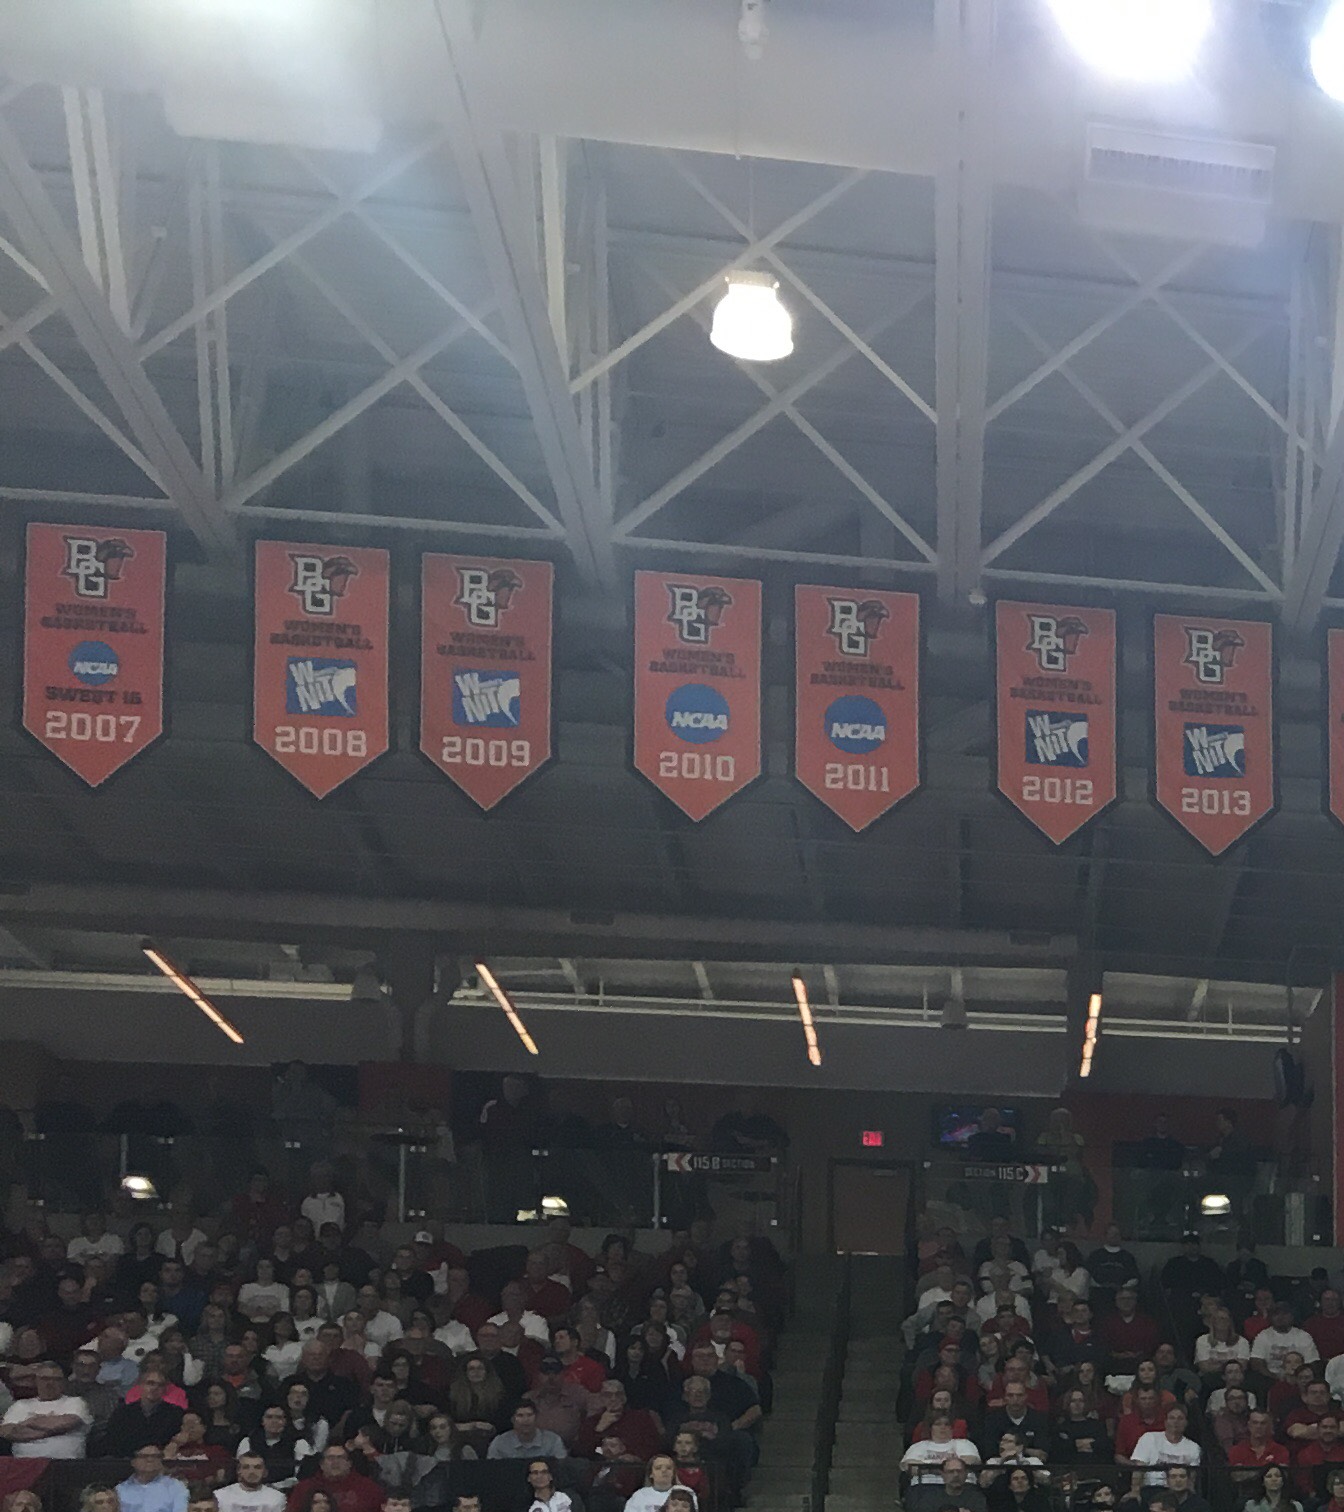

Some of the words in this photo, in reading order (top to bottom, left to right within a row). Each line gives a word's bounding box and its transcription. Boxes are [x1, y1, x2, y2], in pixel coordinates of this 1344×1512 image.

[45, 711, 143, 743] 2007
[671, 711, 728, 730] NCAA
[830, 722, 886, 741] NCAA
[275, 726, 367, 757] 2008
[442, 736, 531, 767] 2009
[659, 751, 736, 782] 2010
[825, 763, 890, 793] 2011
[1022, 775, 1093, 805] 2012
[1181, 787, 1251, 816] 2013
